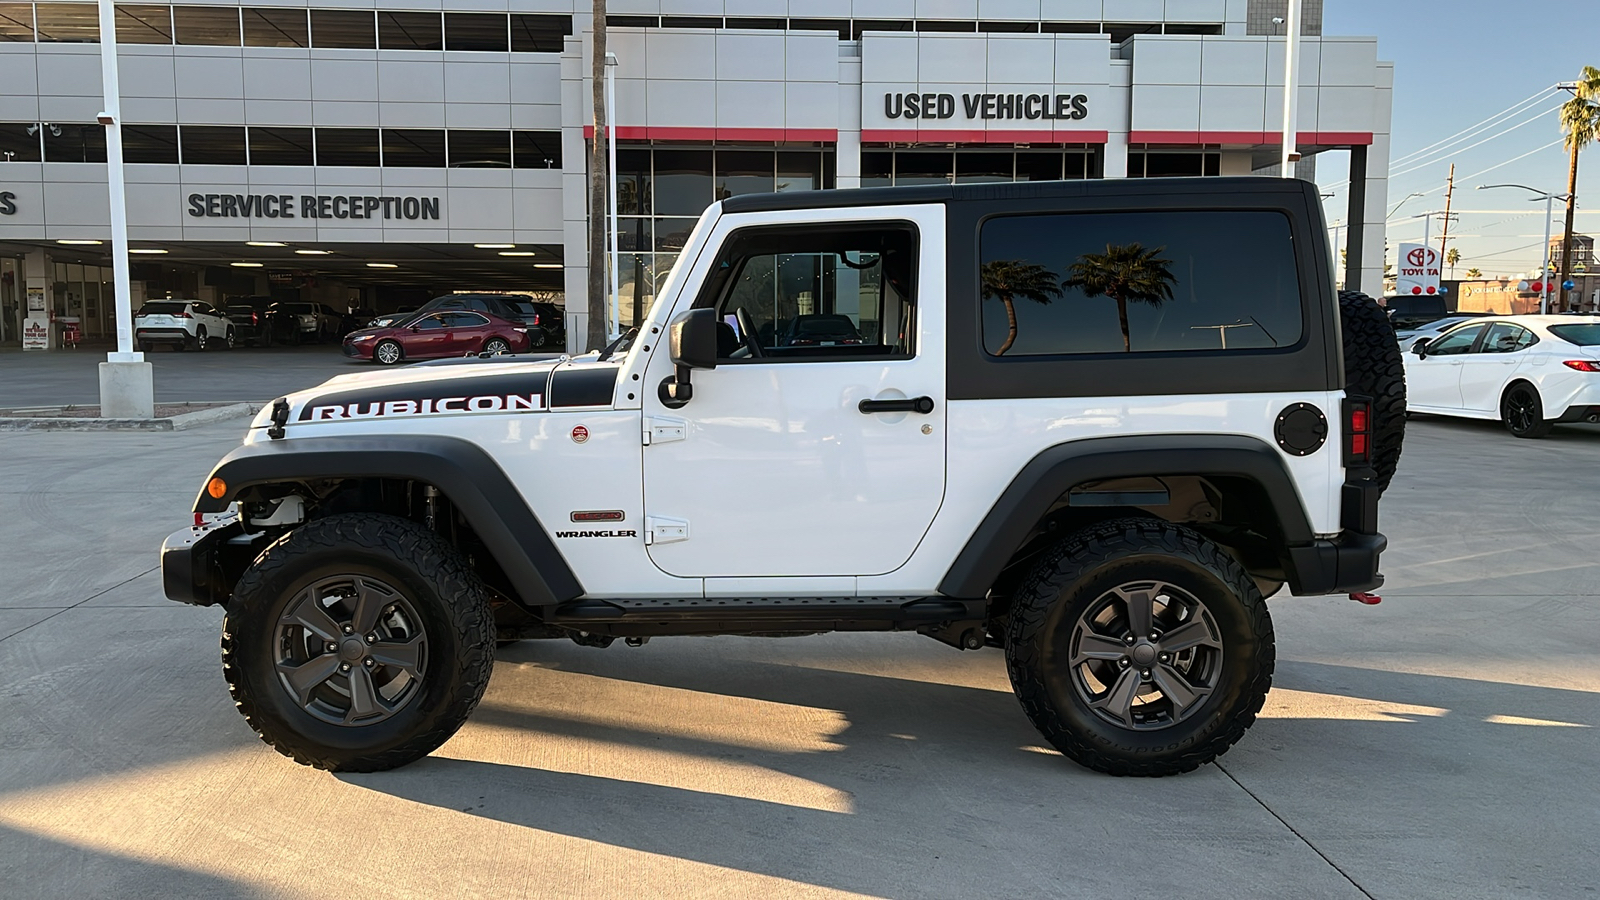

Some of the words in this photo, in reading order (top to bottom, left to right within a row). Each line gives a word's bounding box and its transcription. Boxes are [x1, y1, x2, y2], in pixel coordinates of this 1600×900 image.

[884, 93, 955, 119] USED
[962, 93, 1088, 120] VEHICLES
[188, 193, 294, 219] SERVICE
[300, 195, 440, 220] RECEPTION
[310, 393, 543, 421] RUBICON
[555, 530, 638, 539] WRANGLER
